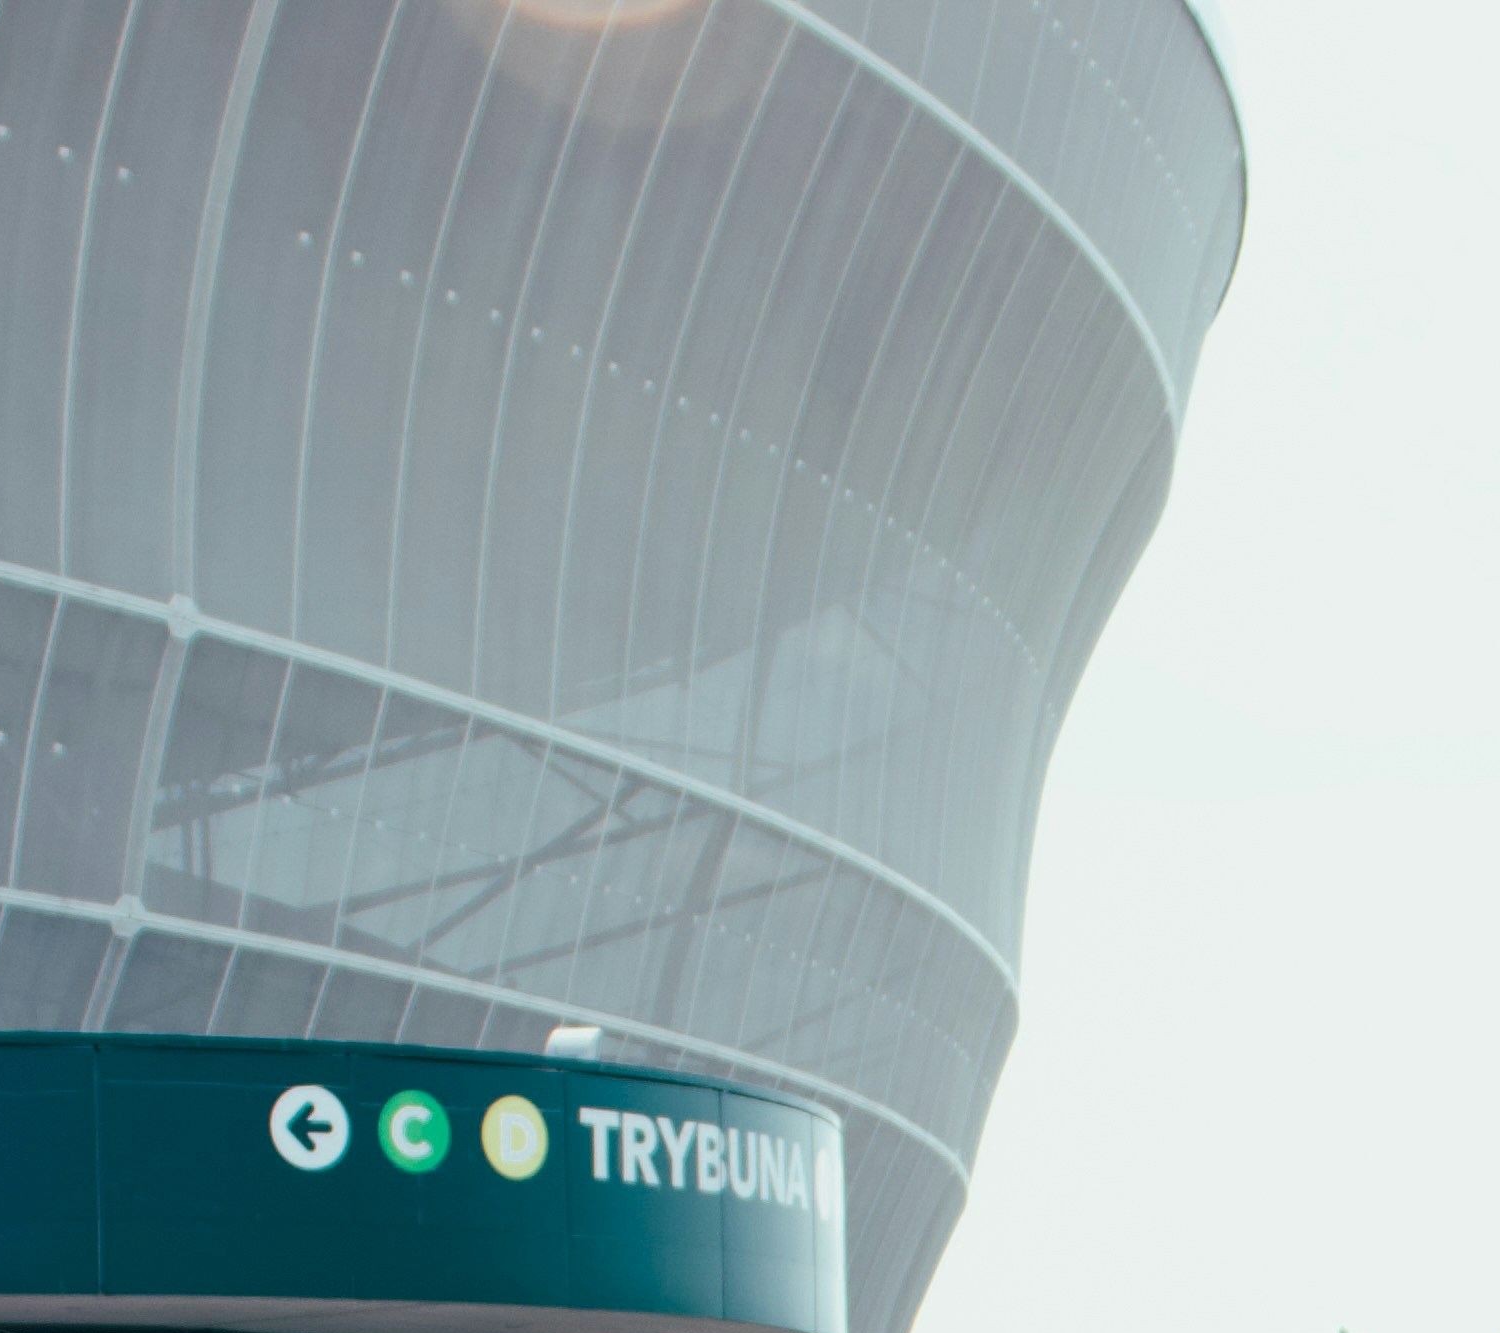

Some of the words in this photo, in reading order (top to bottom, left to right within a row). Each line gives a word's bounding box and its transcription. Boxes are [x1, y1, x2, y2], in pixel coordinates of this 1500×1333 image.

[391, 1106, 434, 1158] C
[500, 1113, 539, 1164] D
[579, 1107, 809, 1208] TRYBUNA
